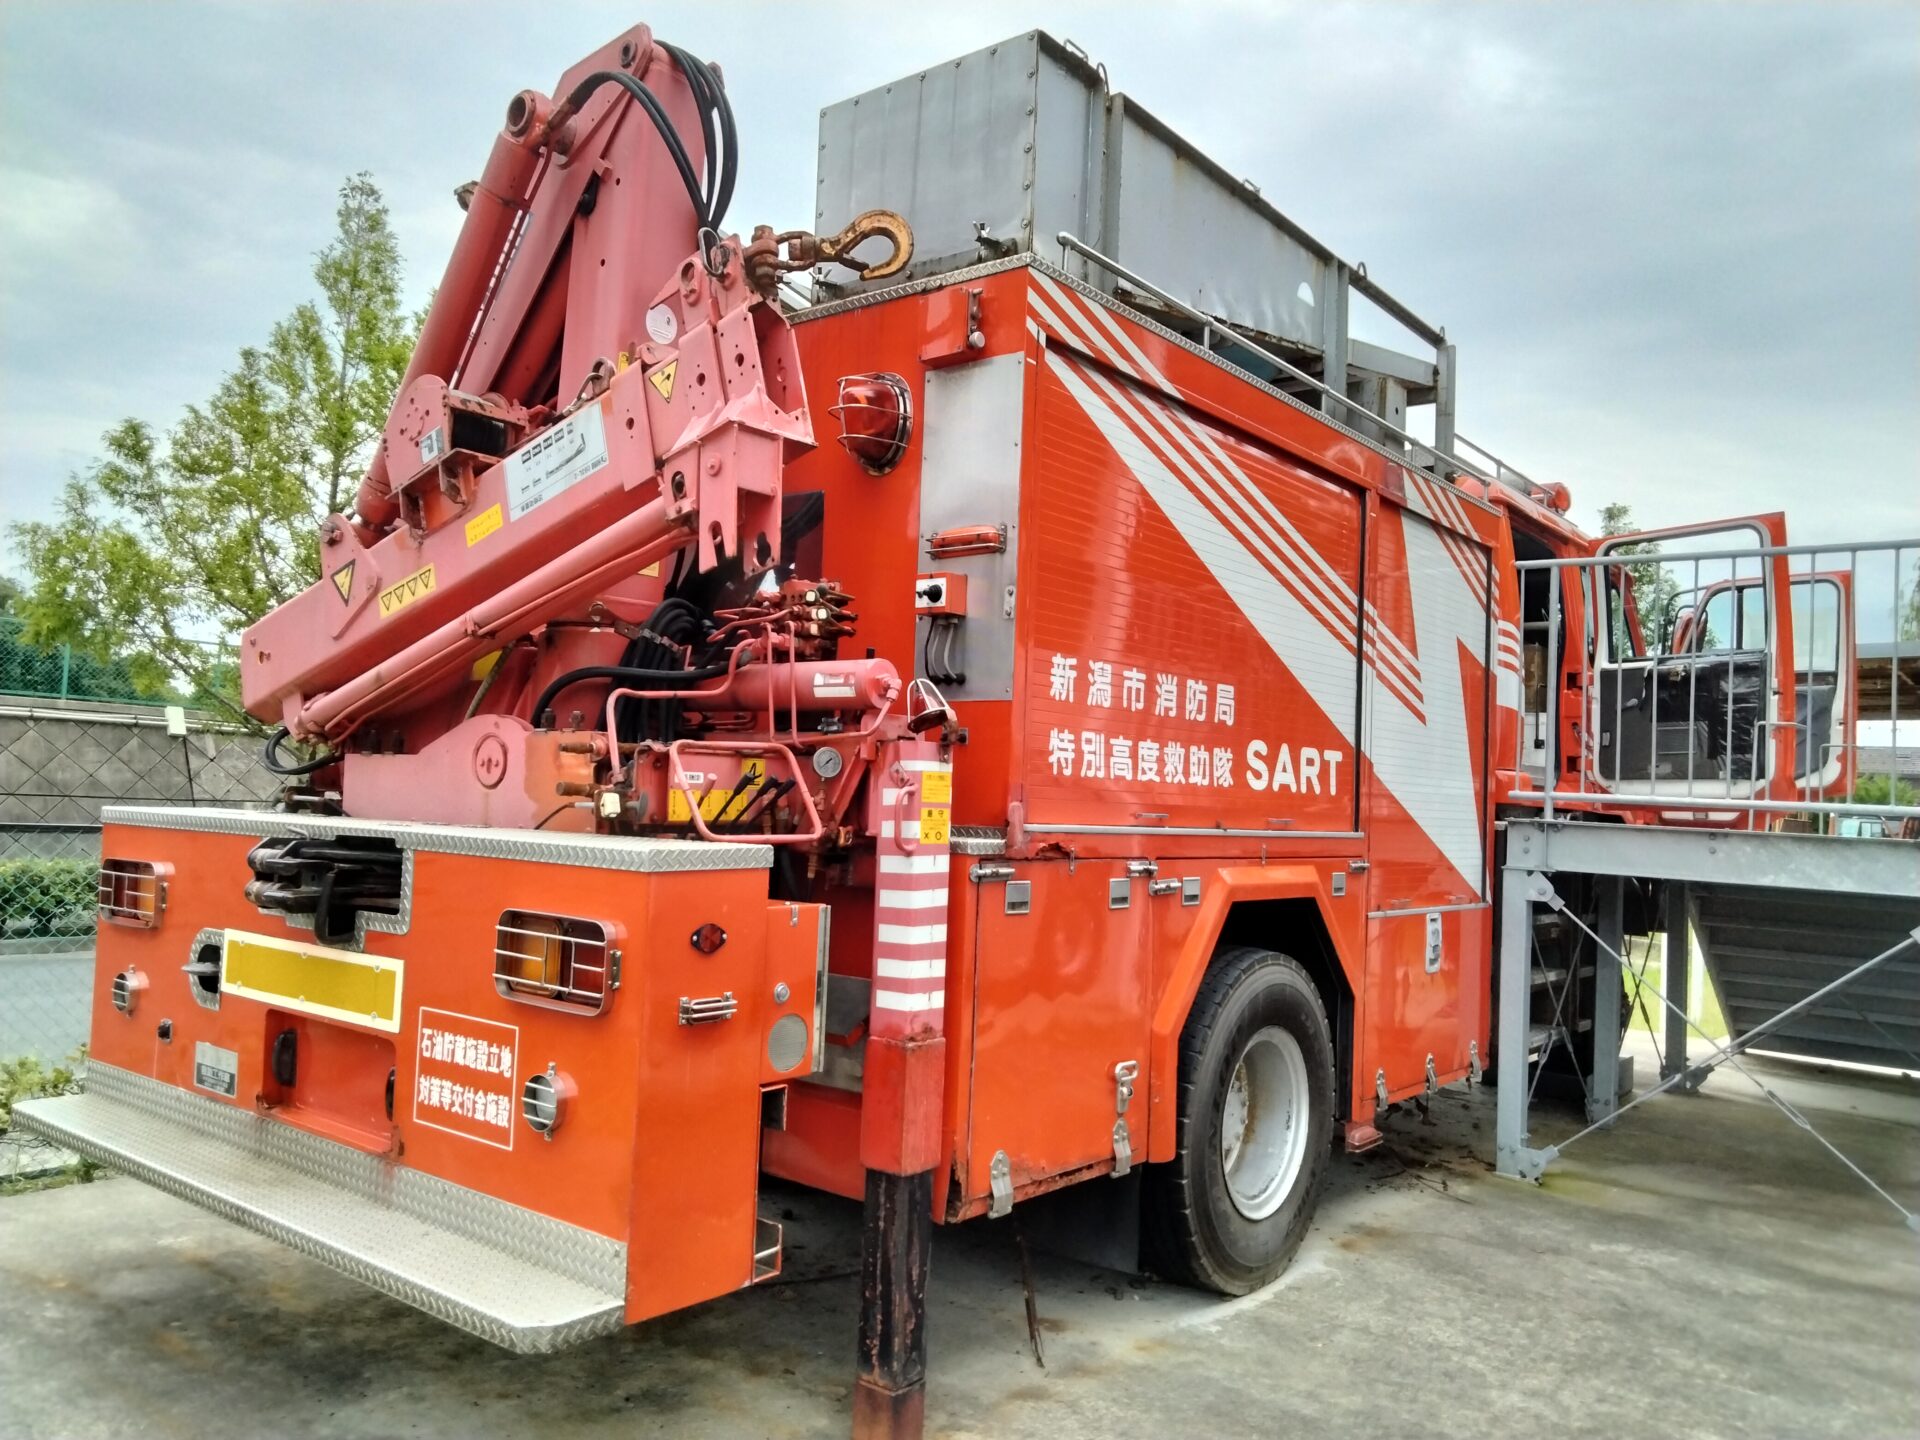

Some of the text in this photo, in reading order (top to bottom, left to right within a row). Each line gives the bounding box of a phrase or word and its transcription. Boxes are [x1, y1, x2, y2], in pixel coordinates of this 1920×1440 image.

[1050, 653, 1235, 726] 新潟市消防局
[1048, 727, 1343, 797] 特別高度救助隊 SART
[421, 1027, 512, 1079] 石油貯蔵施設立地
[418, 1073, 511, 1129] 対策等交付金施設
